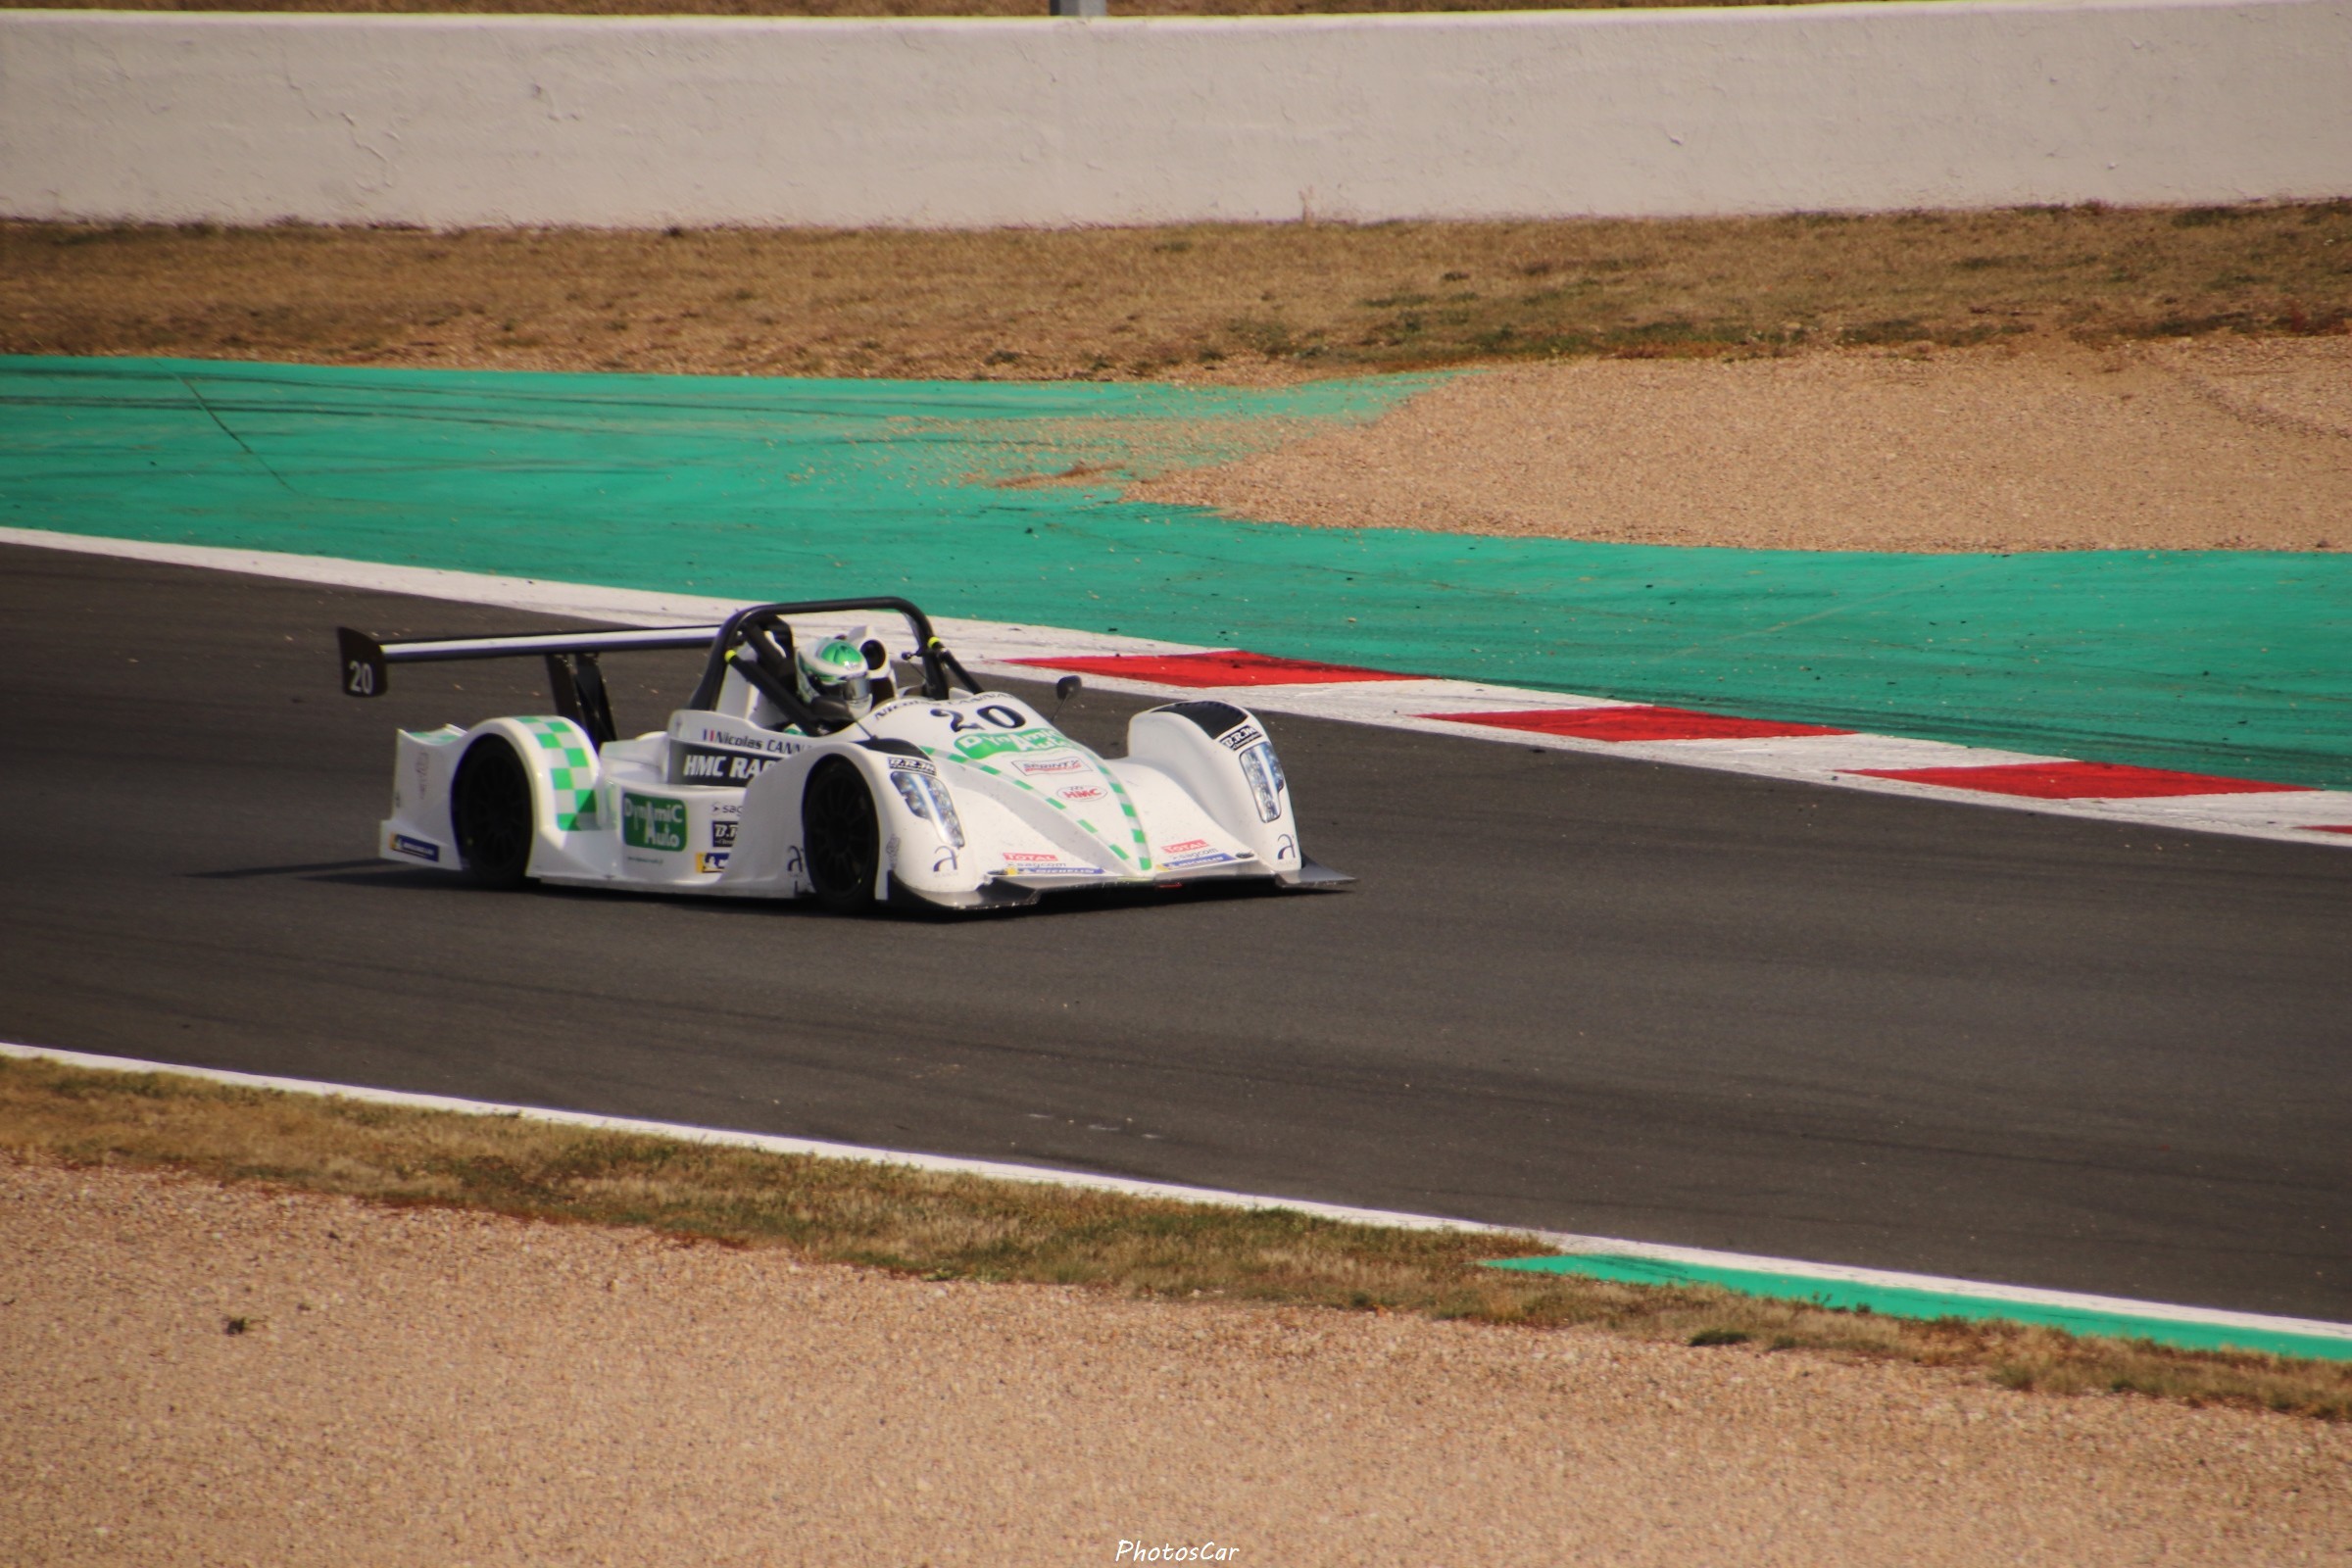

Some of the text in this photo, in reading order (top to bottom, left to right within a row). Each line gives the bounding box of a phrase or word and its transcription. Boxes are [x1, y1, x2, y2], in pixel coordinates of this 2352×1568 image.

[349, 660, 373, 695] 20
[929, 705, 1026, 733] 20
[716, 731, 762, 750] Nicolas
[683, 754, 727, 778] HMC
[1062, 788, 1102, 799] HMC
[1163, 840, 1206, 854] TOTAL
